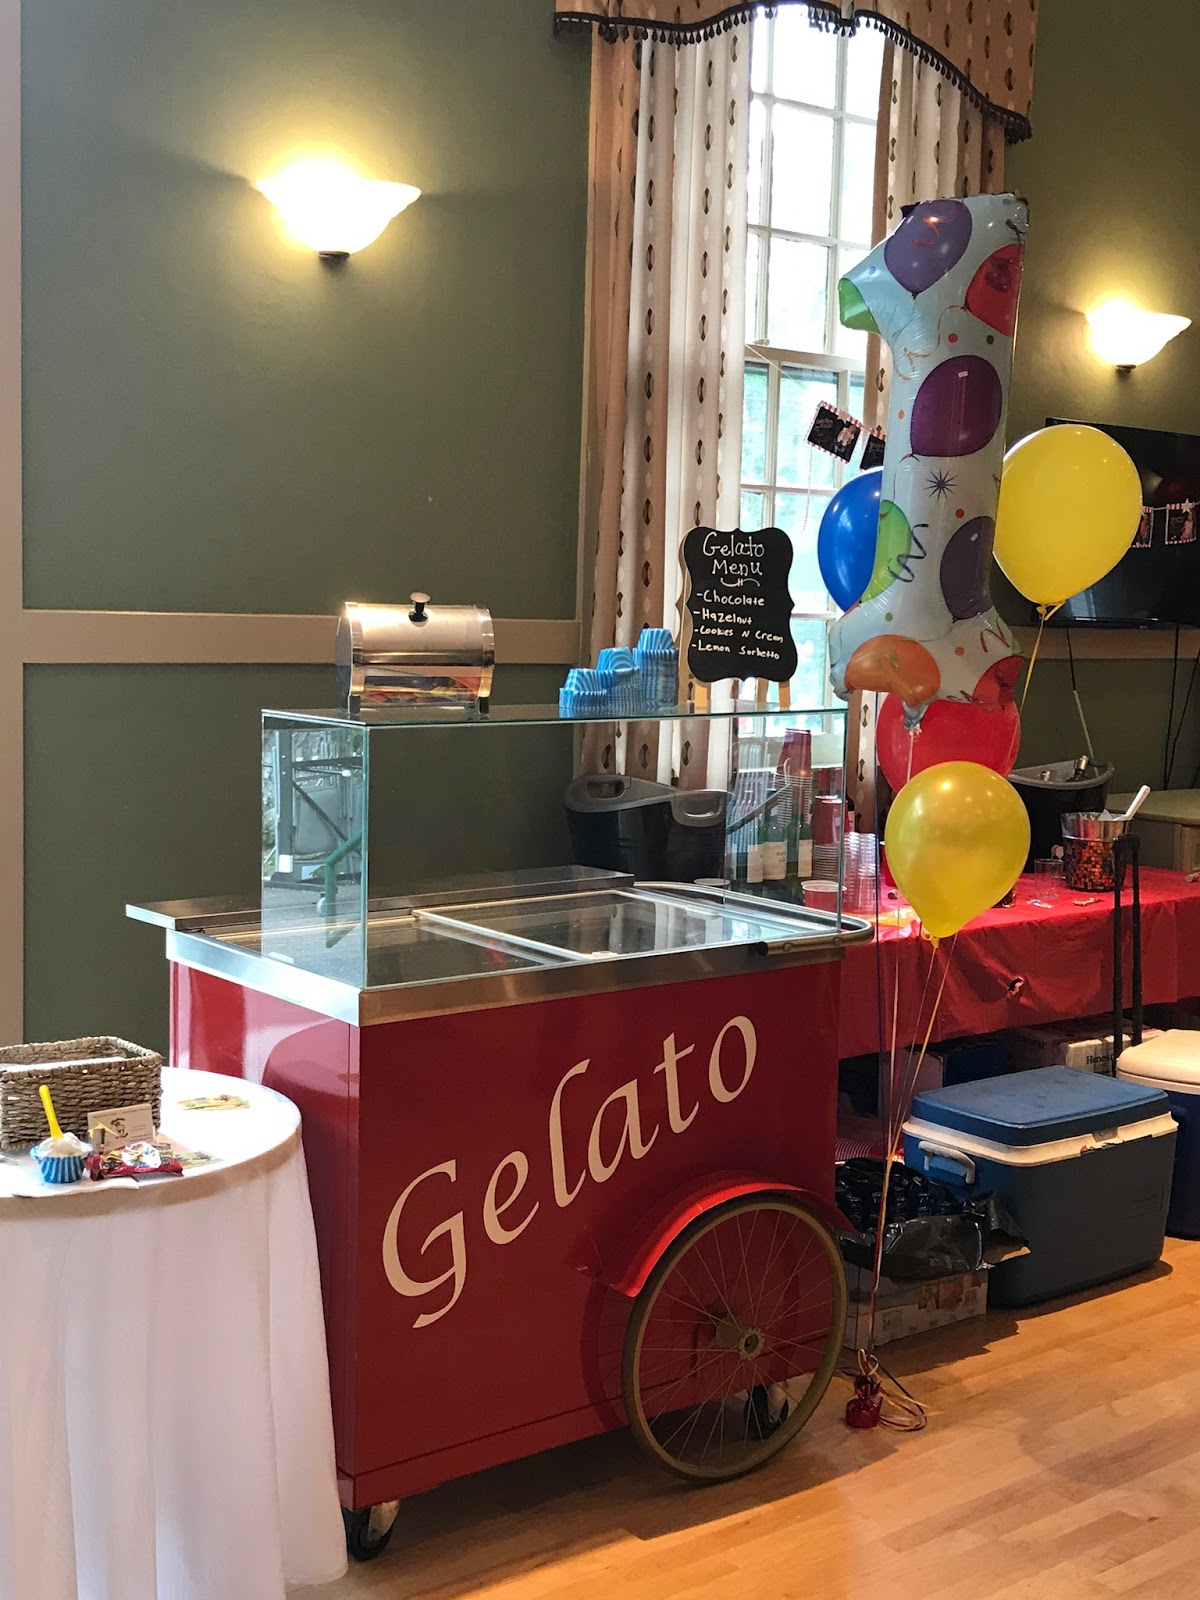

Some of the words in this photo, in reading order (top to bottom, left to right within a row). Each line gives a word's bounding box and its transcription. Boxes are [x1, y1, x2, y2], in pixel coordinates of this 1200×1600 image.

[702, 531, 765, 558] Gelato
[711, 559, 763, 576] Menu
[741, 630, 750, 638] N
[382, 1015, 757, 1328] Gelato
